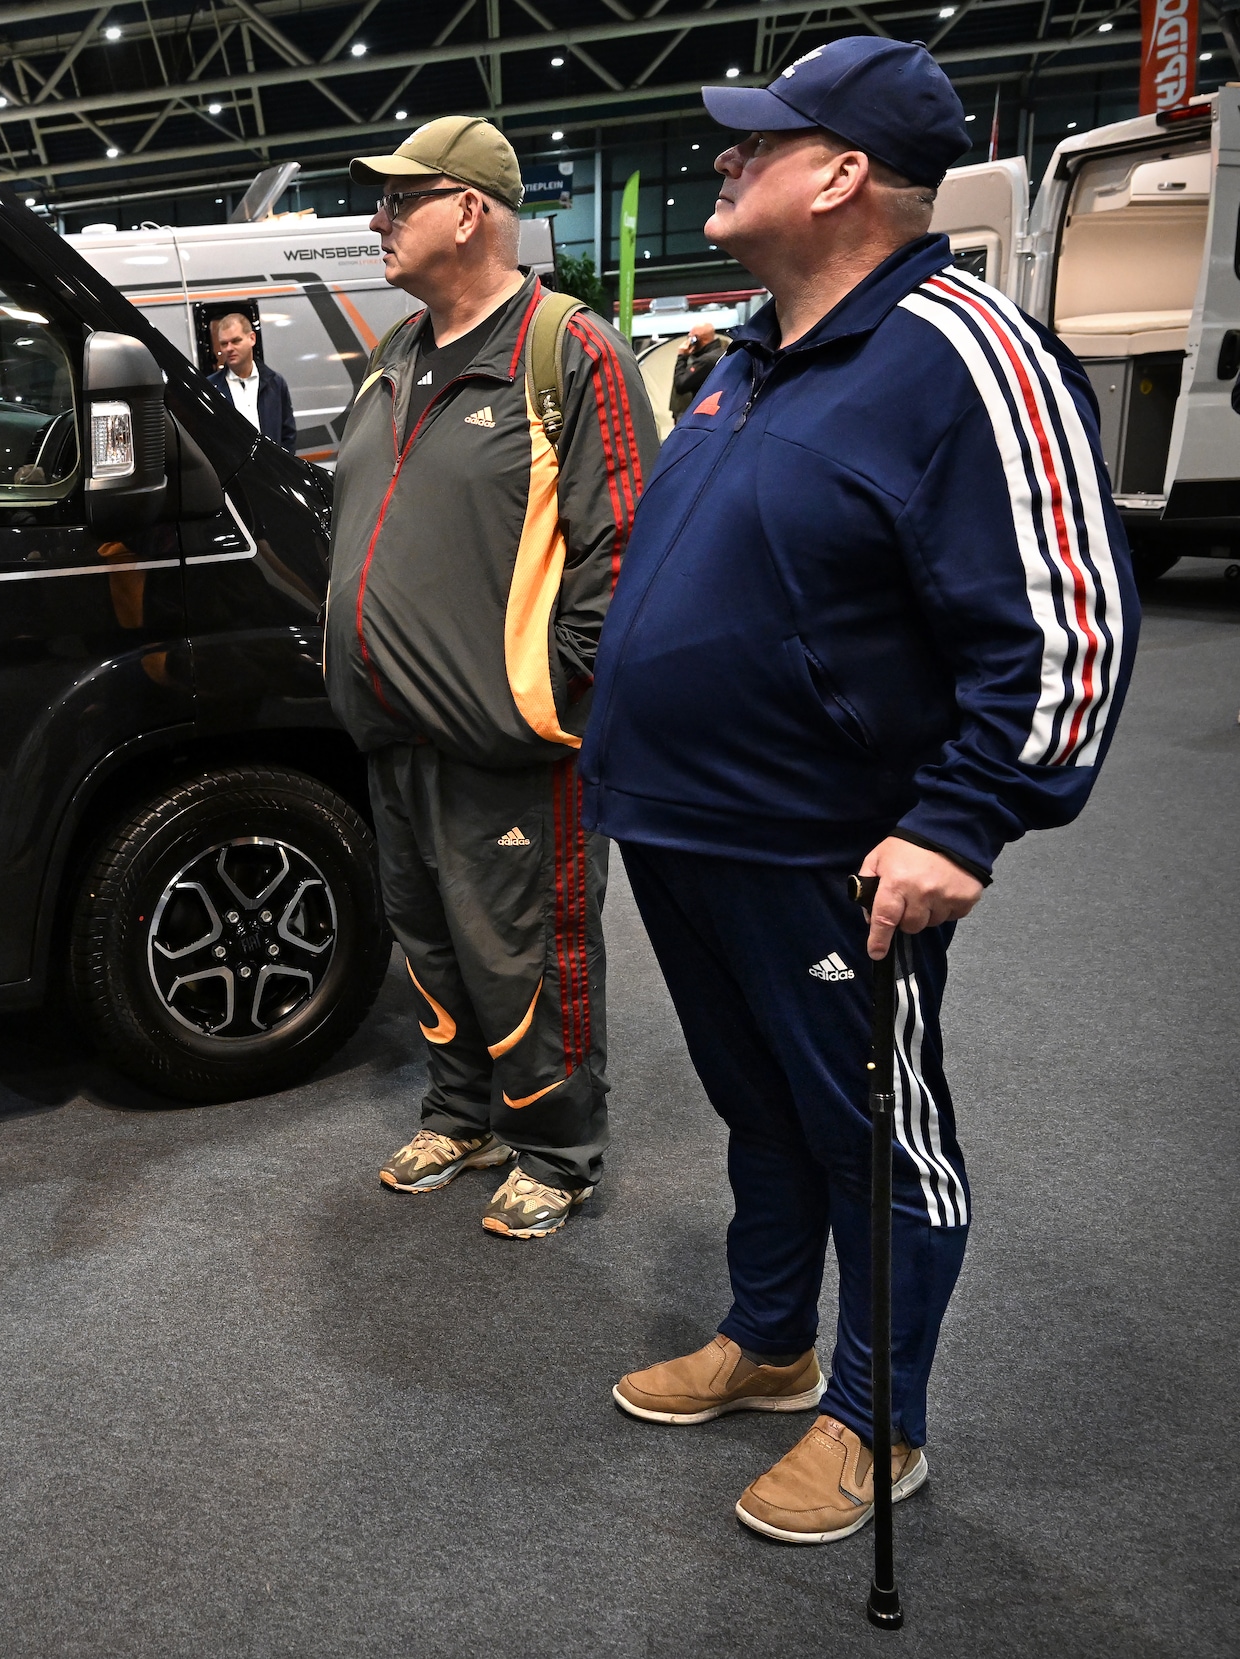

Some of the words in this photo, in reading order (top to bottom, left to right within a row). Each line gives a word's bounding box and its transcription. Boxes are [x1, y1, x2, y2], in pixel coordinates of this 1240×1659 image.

[1154, 0, 1188, 113] APIDO
[283, 245, 380, 261] WEINSBERG
[464, 416, 496, 428] adidas
[497, 838, 530, 846] adidas
[808, 968, 855, 981] adidas
